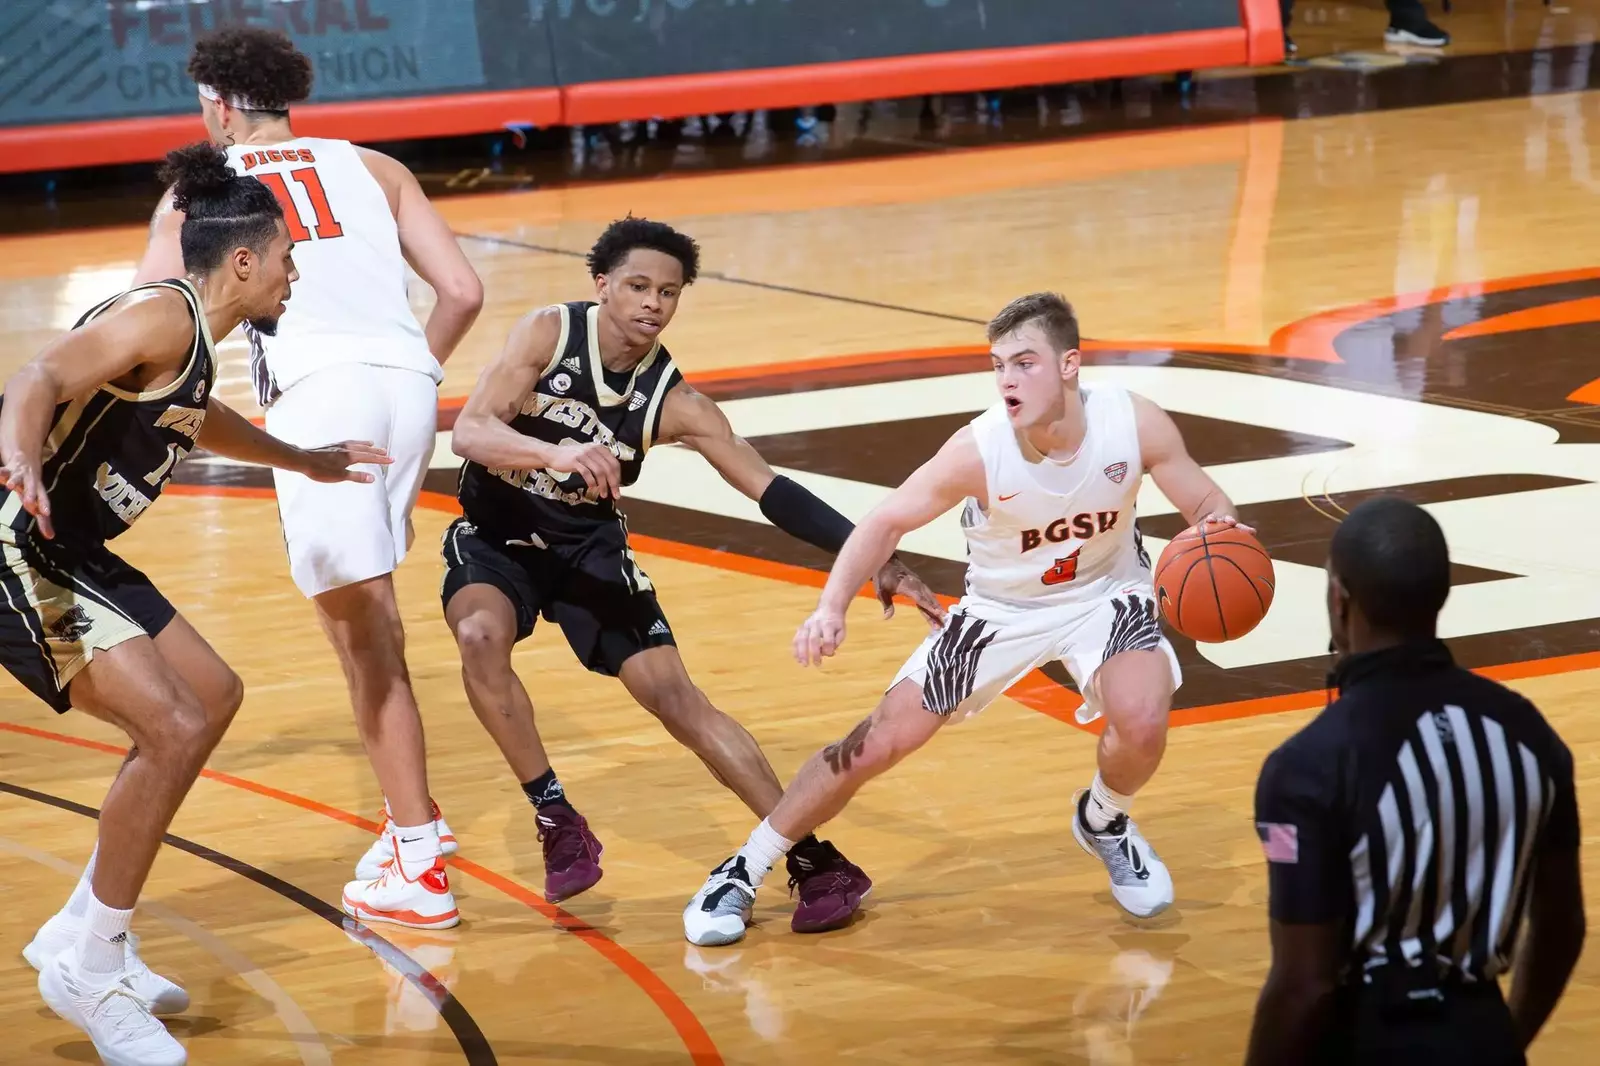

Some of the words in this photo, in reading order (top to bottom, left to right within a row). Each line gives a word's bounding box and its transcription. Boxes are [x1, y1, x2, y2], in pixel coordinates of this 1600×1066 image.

[316, 46, 419, 88] NION
[241, 148, 316, 171] DIGGS
[255, 166, 345, 243] 11
[1020, 510, 1120, 554] BGSU
